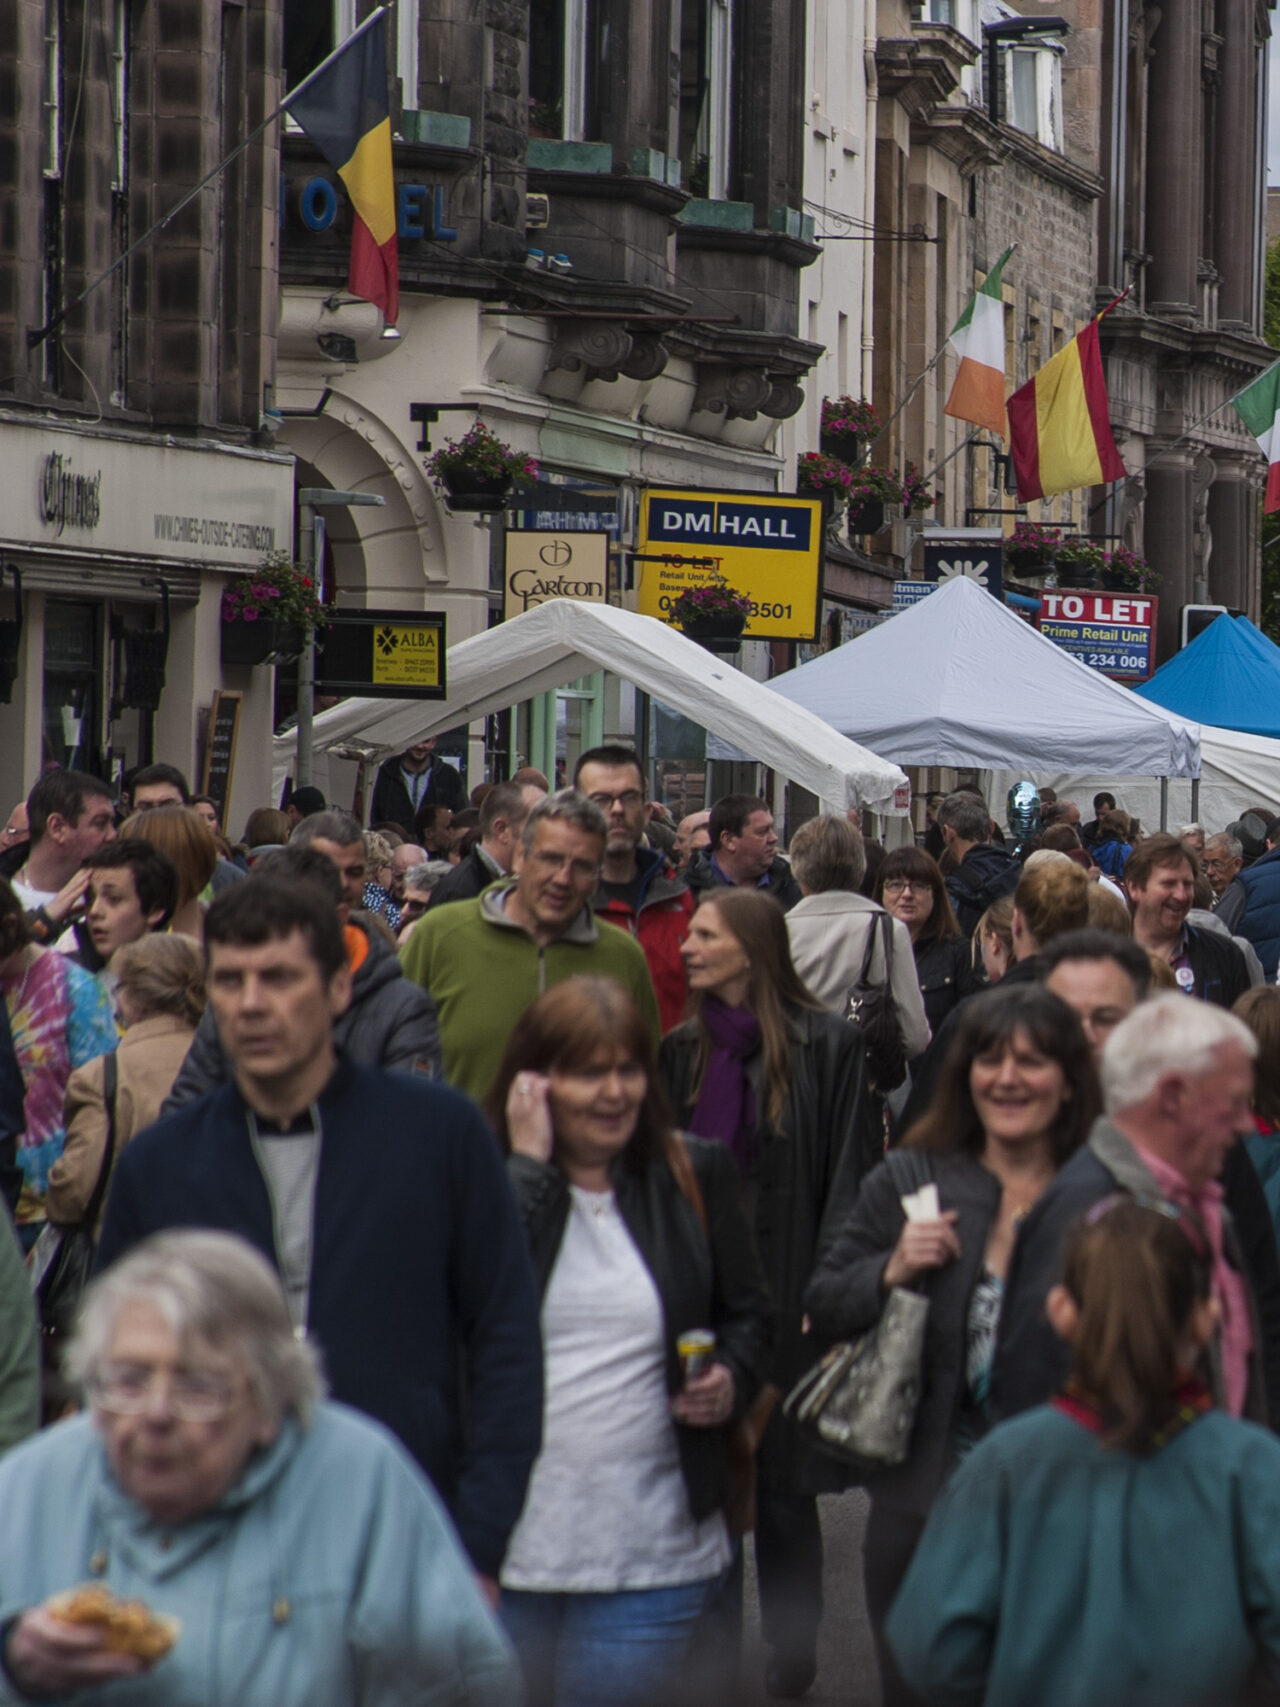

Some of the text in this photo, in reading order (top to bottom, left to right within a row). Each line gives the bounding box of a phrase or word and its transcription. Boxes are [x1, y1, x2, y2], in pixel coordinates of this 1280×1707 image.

[280, 175, 457, 240] OEL
[663, 511, 796, 538] DM HALL
[659, 570, 685, 580] Retail
[1042, 594, 1084, 619] TO
[1093, 598, 1151, 623] LET
[400, 632, 436, 648] ALBA
[1041, 624, 1148, 643] Prime Retail Unit
[1088, 653, 1116, 667] 234
[1119, 656, 1148, 669] 006
